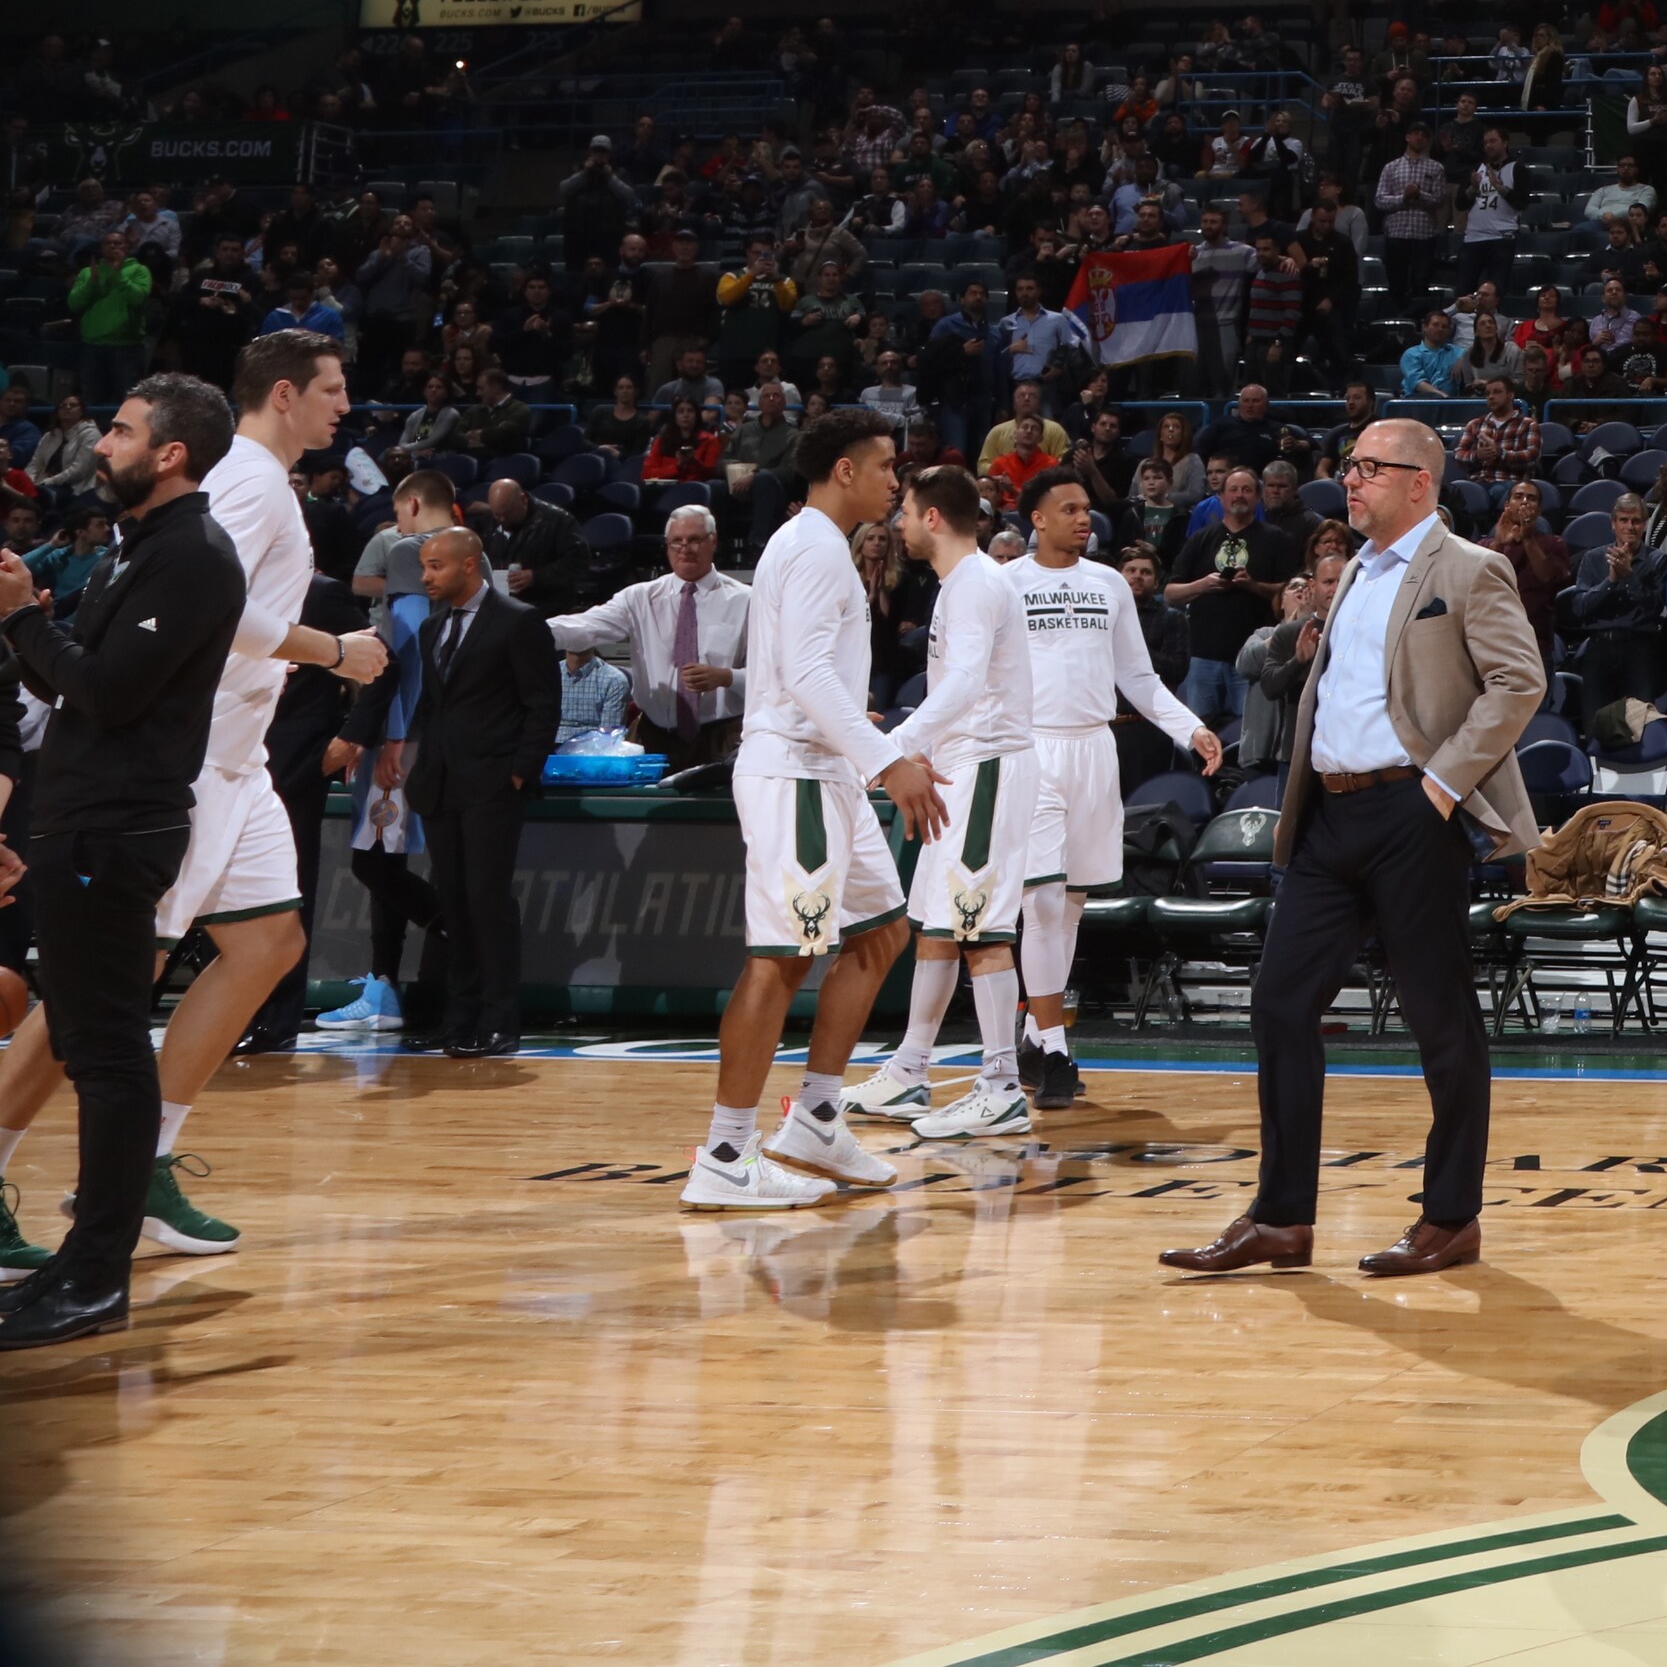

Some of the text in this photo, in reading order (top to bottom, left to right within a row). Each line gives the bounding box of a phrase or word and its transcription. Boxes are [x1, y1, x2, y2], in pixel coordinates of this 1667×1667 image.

[150, 139, 272, 159] BUCKS.COM
[1480, 196, 1498, 211] 34
[1023, 592, 1107, 608] MILWAUKEE
[1026, 615, 1109, 631] BASKETBALL
